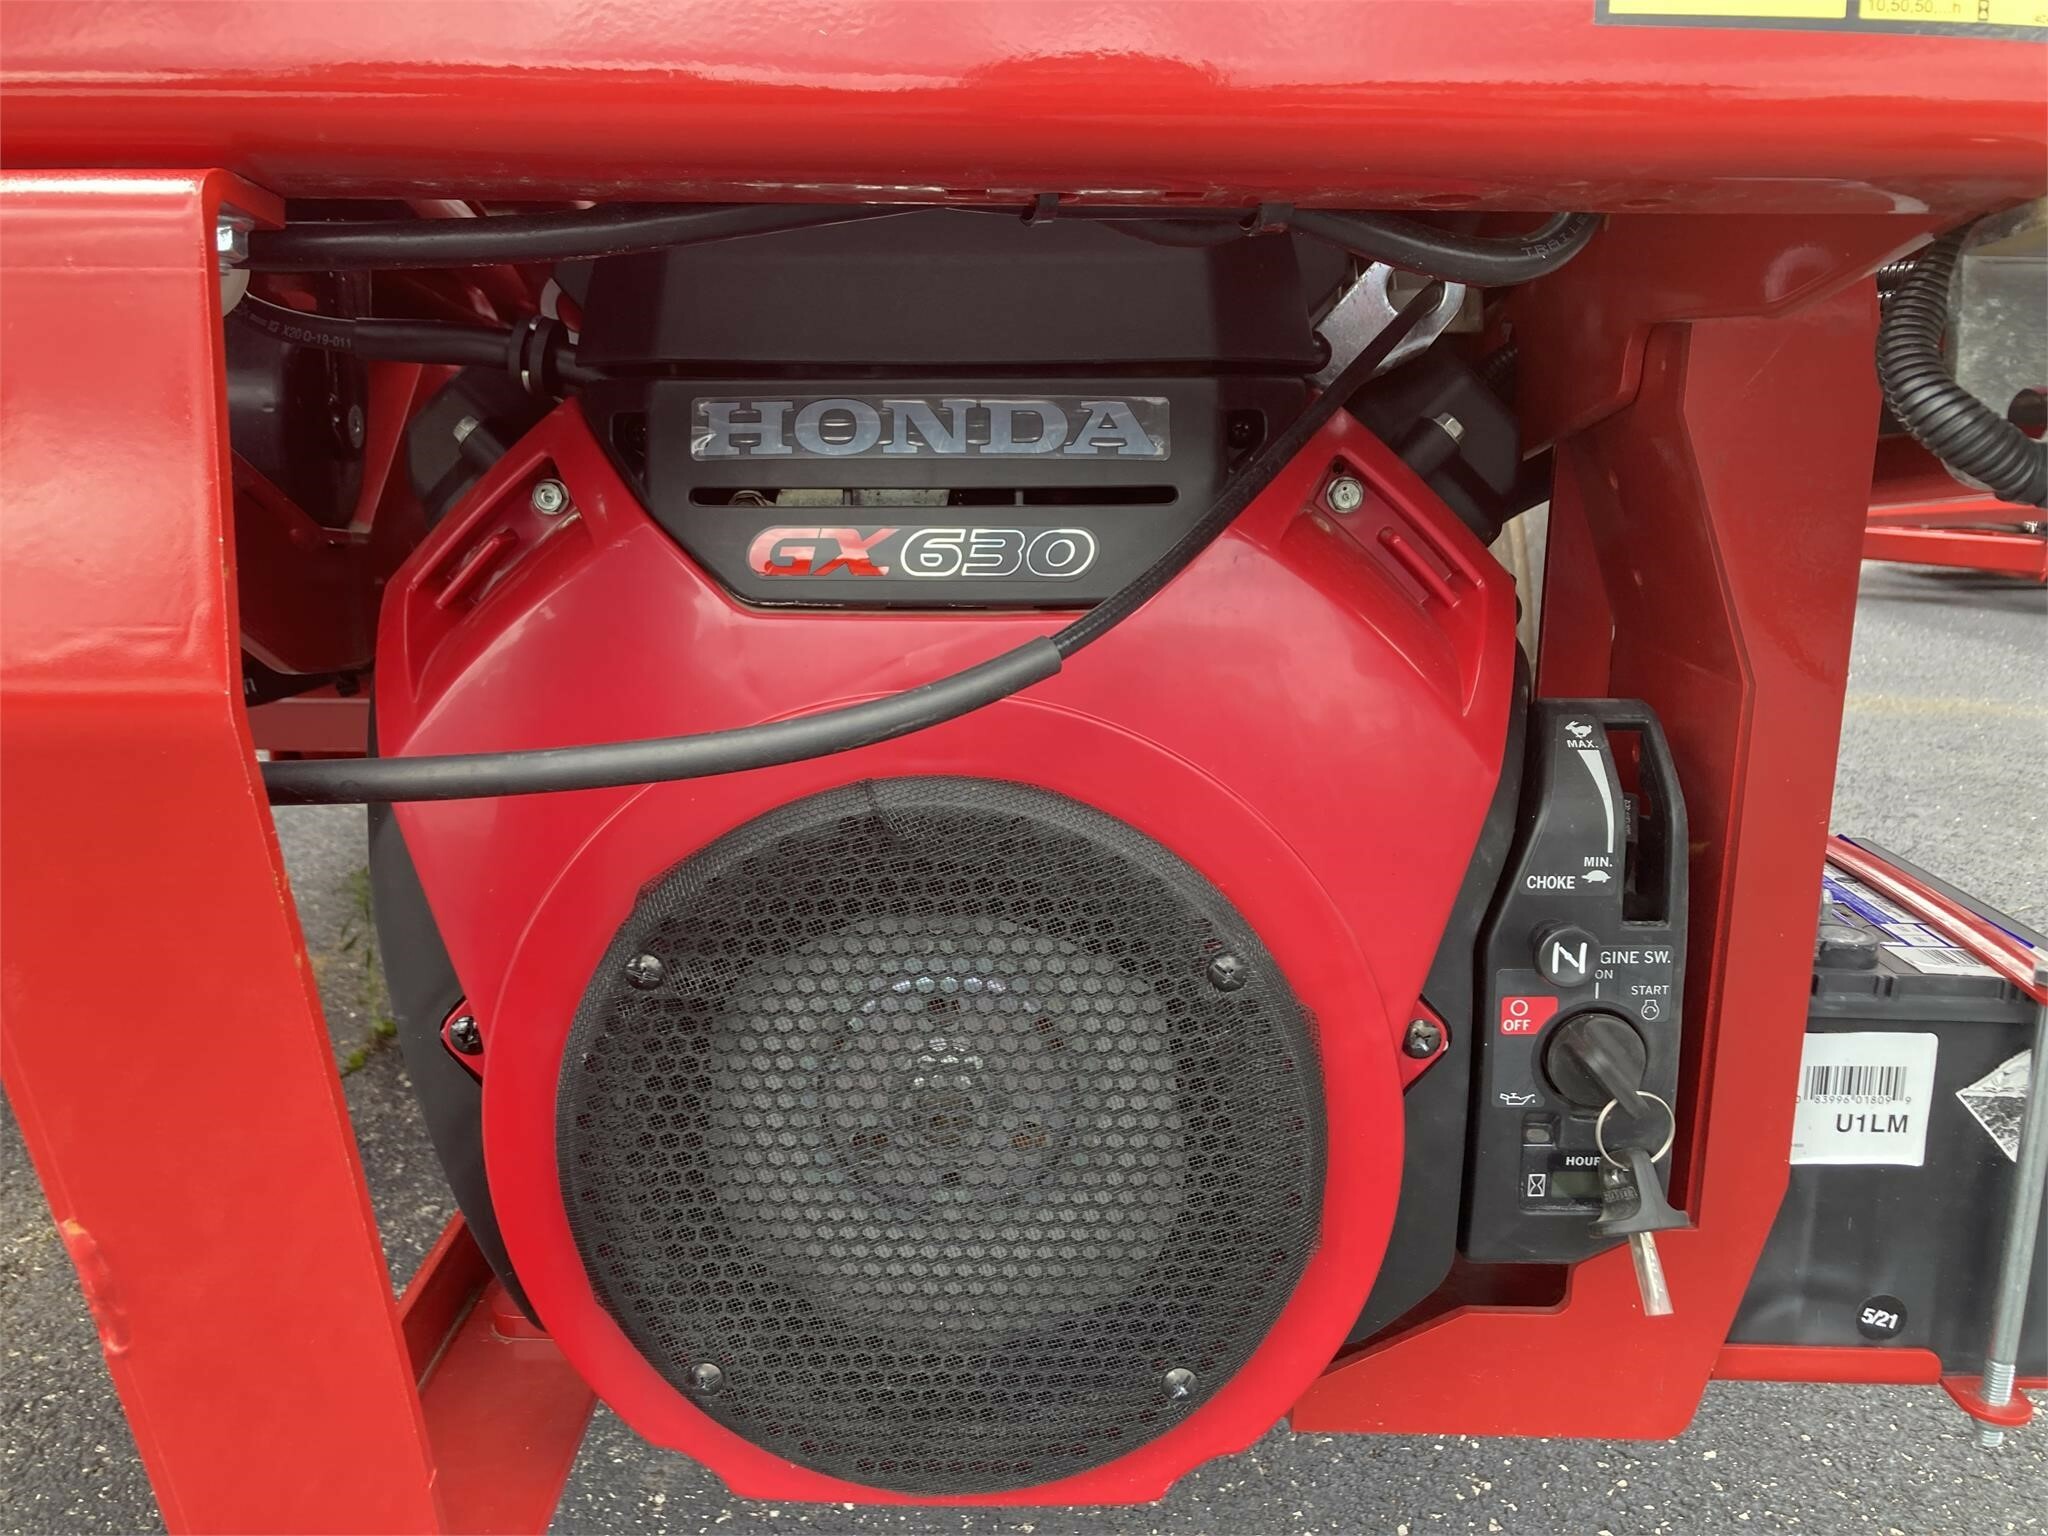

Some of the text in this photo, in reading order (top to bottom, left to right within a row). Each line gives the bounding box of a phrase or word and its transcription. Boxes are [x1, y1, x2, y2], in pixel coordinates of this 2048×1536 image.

[701, 399, 1161, 456] HONDA
[747, 527, 1096, 577] GX 630
[1566, 739, 1599, 749] MAX.
[1583, 856, 1613, 868] MIN.
[1526, 875, 1576, 890] CHOKE
[1600, 950, 1671, 964] GINE SW.
[1594, 969, 1614, 980] ON
[1631, 985, 1670, 996] START
[1503, 1019, 1532, 1032] OFF
[1836, 1113, 1909, 1133] U1LM
[1861, 1307, 1899, 1330] 5/21
